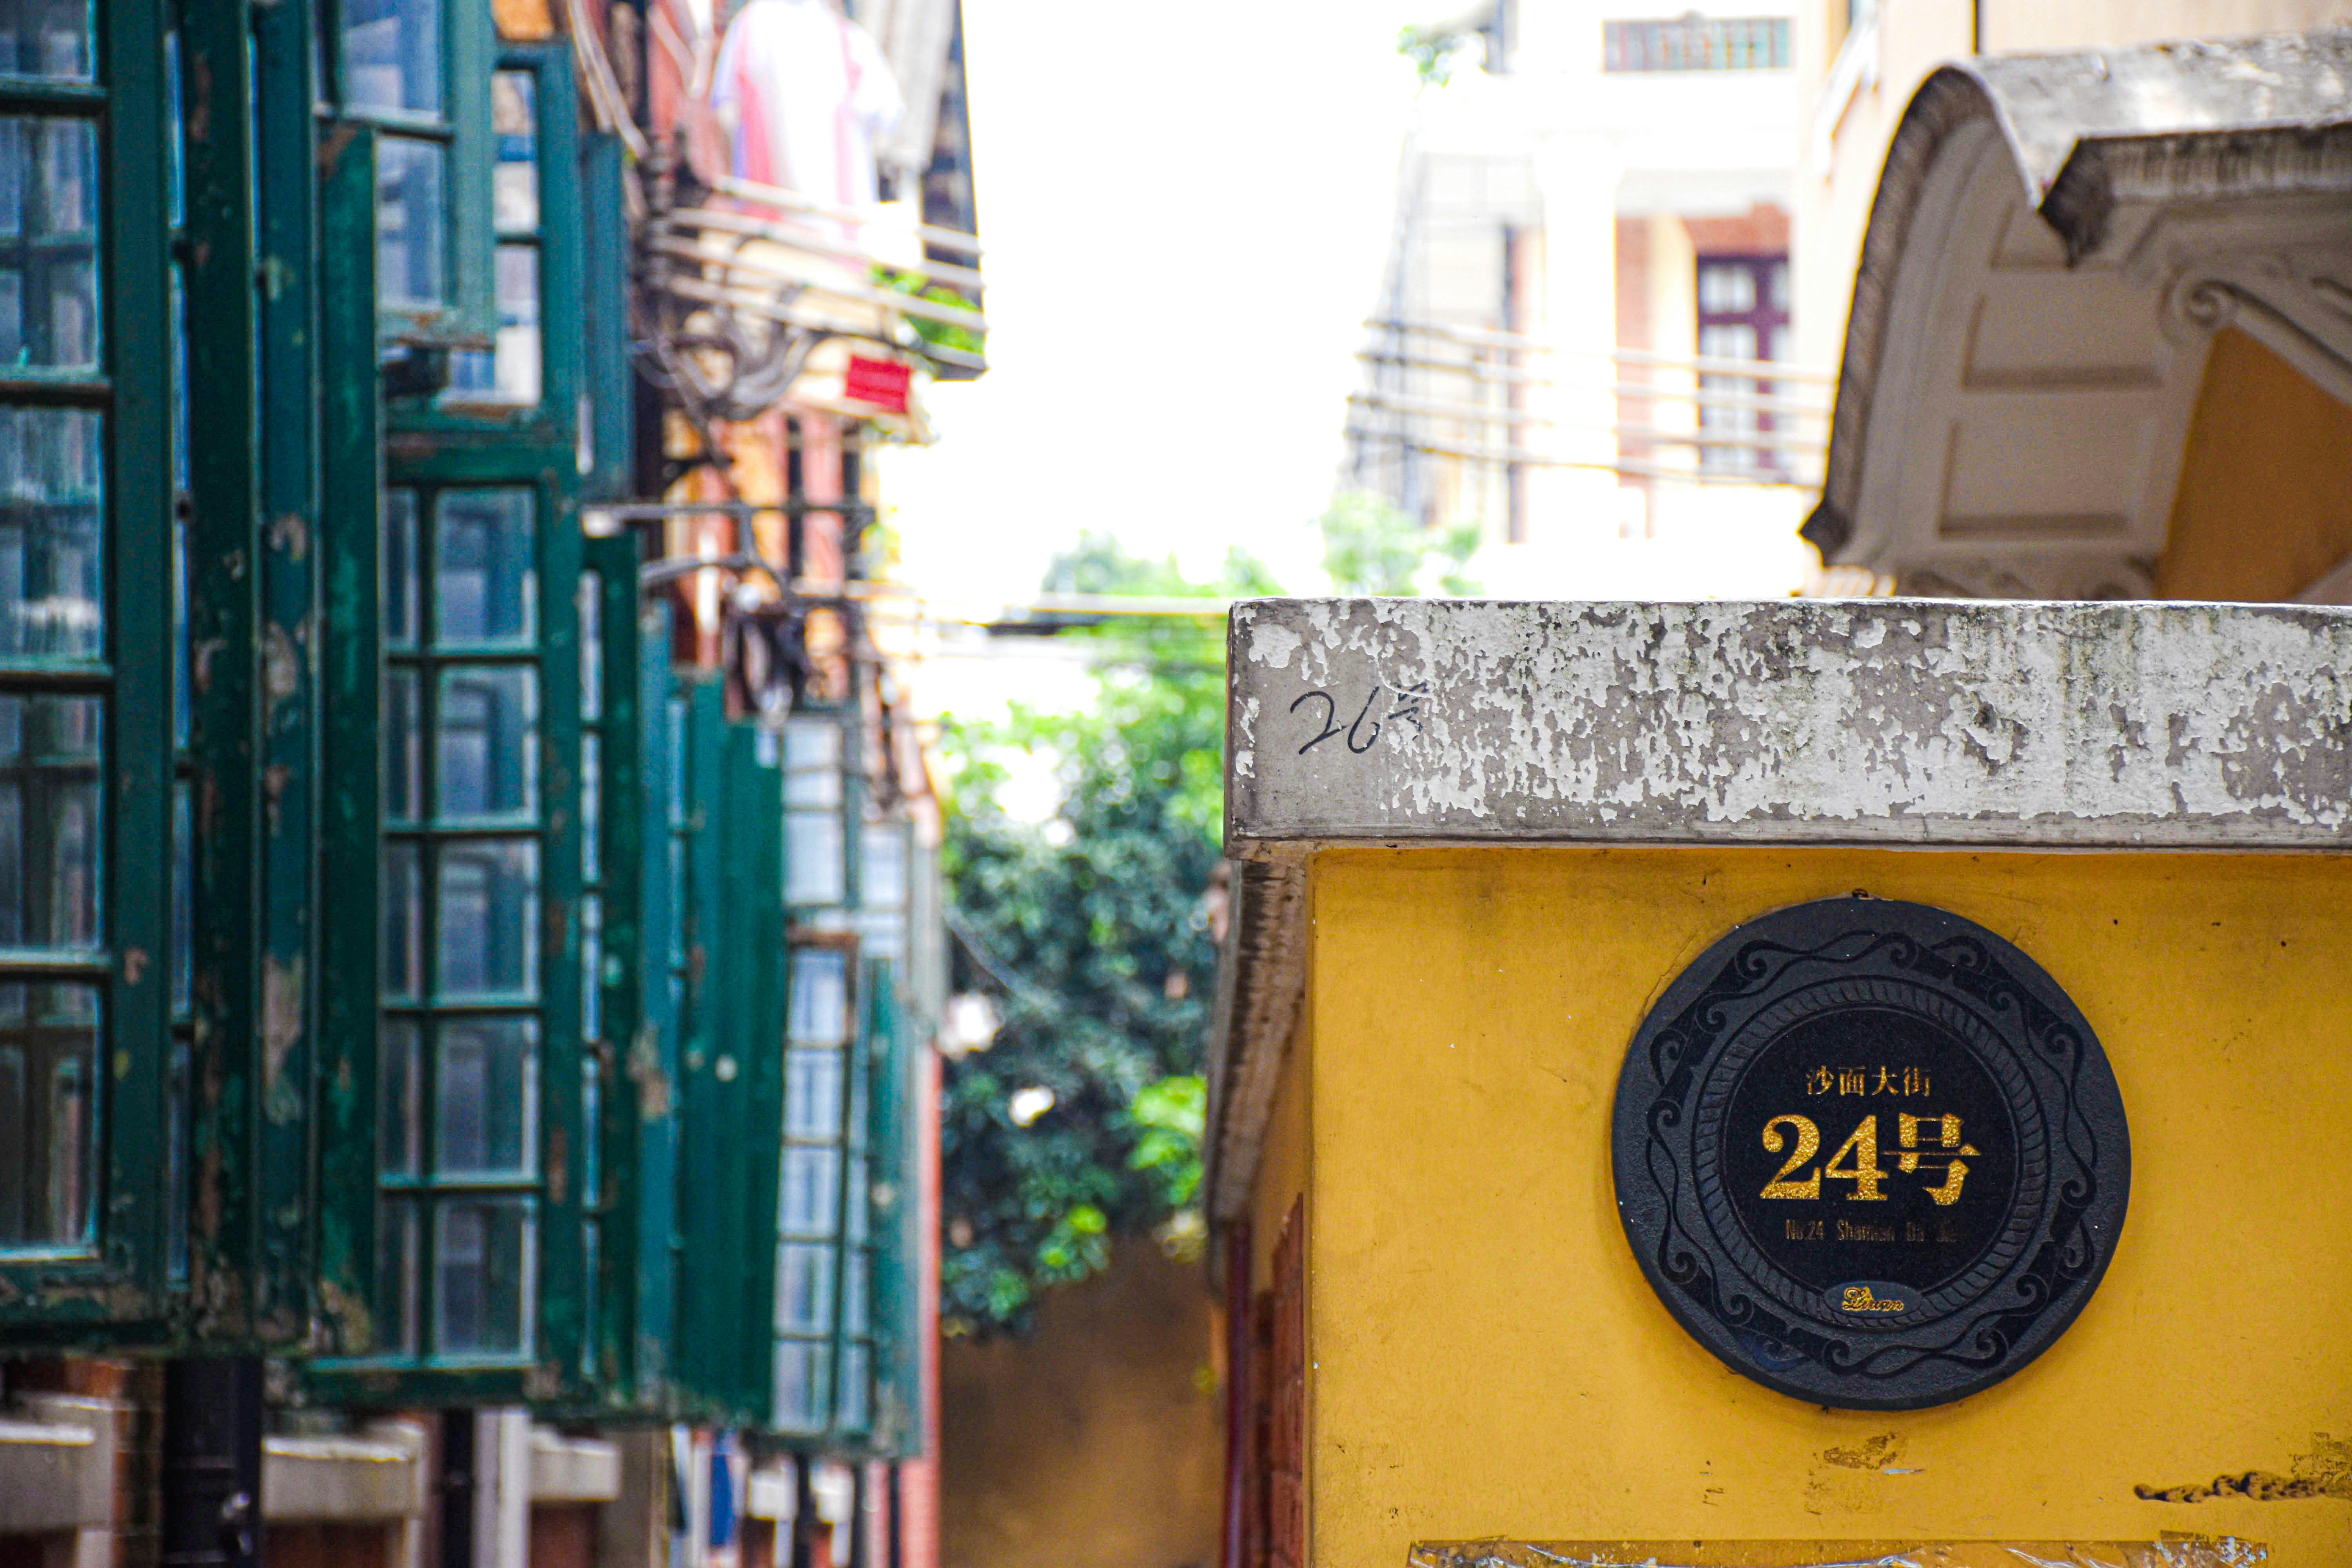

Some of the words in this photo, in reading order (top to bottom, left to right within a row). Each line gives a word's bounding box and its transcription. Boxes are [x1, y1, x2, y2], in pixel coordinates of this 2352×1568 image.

[1806, 1065, 1931, 1097] 沙面大街
[1760, 1112, 1982, 1206] 24号
